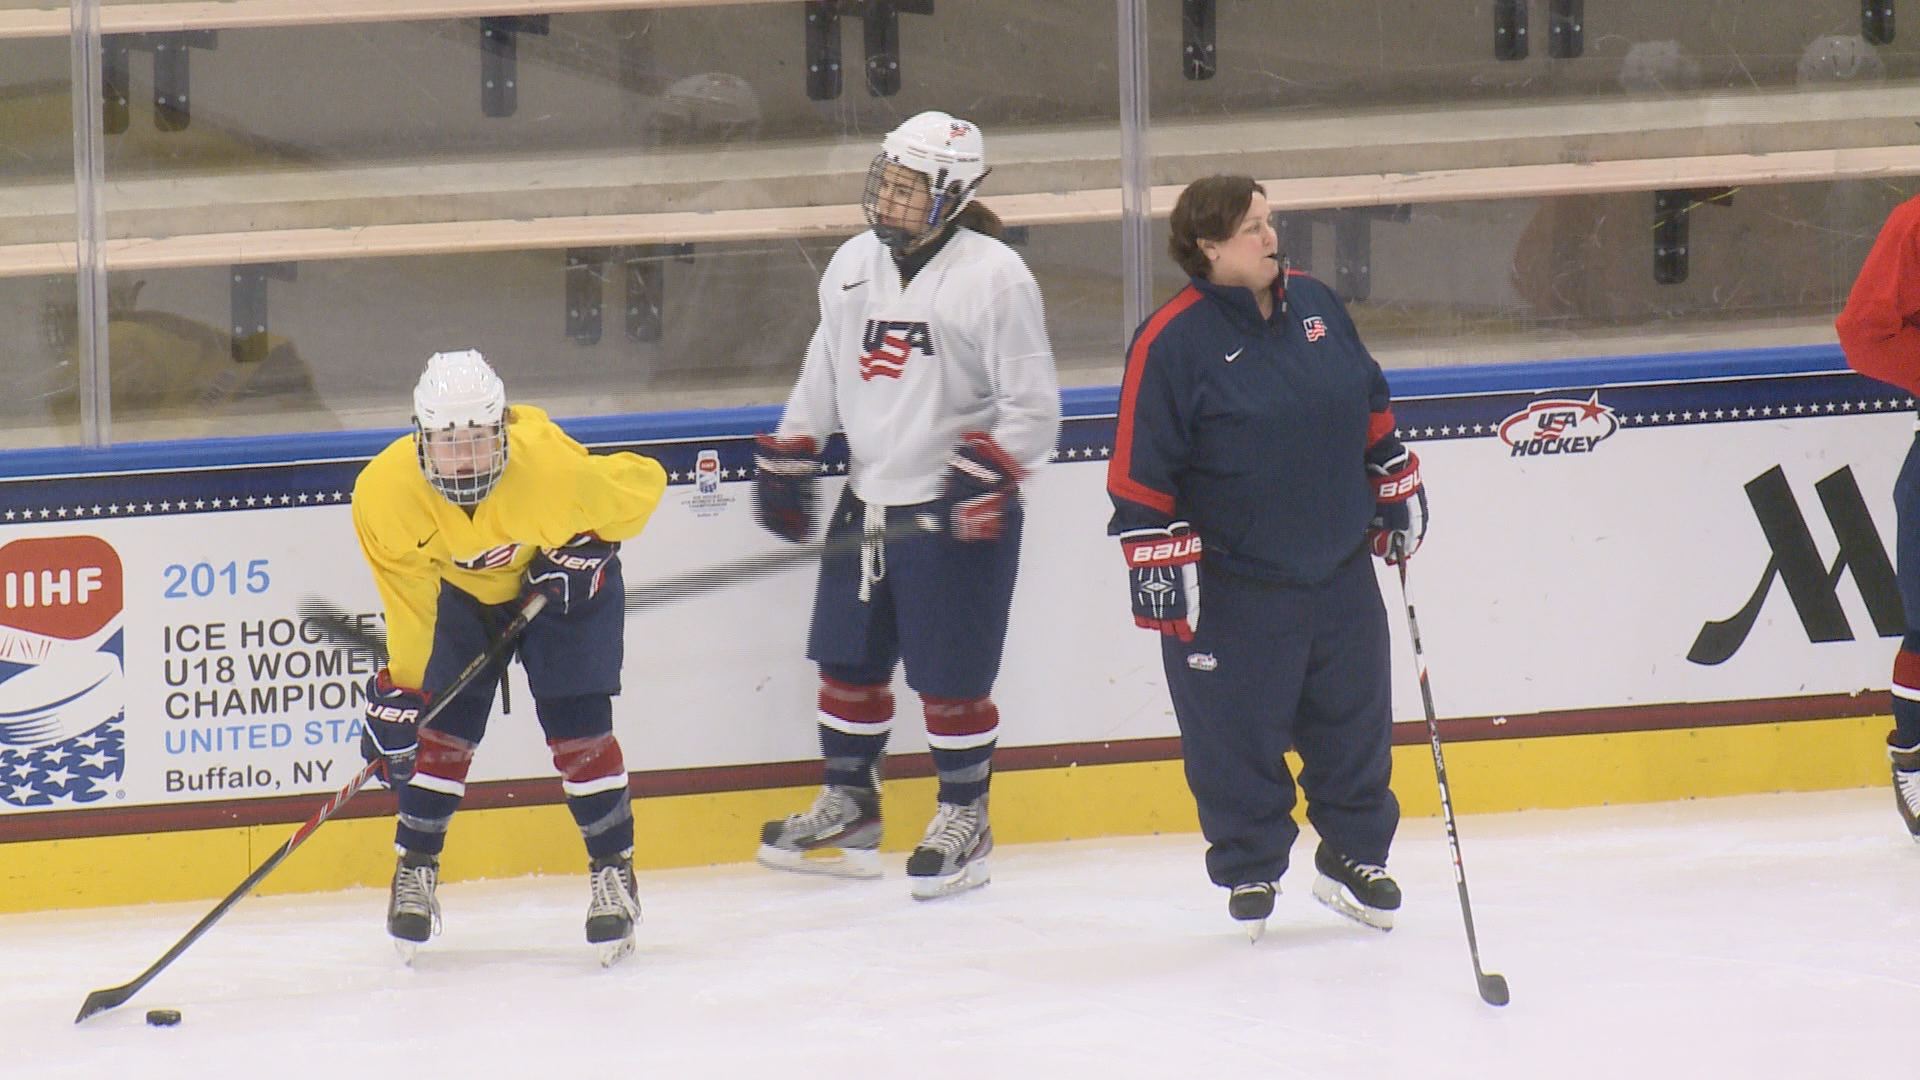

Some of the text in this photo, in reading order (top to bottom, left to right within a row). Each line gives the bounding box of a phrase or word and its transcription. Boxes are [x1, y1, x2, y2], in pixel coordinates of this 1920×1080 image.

[859, 319, 936, 381] USA
[1533, 411, 1577, 440] USA
[1510, 436, 1601, 457] HOCKEY
[5, 567, 103, 608] IIHF
[163, 559, 271, 599] 2015
[164, 612, 387, 653] ICE HOCE
[164, 655, 236, 687] U18
[164, 723, 293, 754] UNITED
[165, 759, 334, 792] Buffalo, NY
